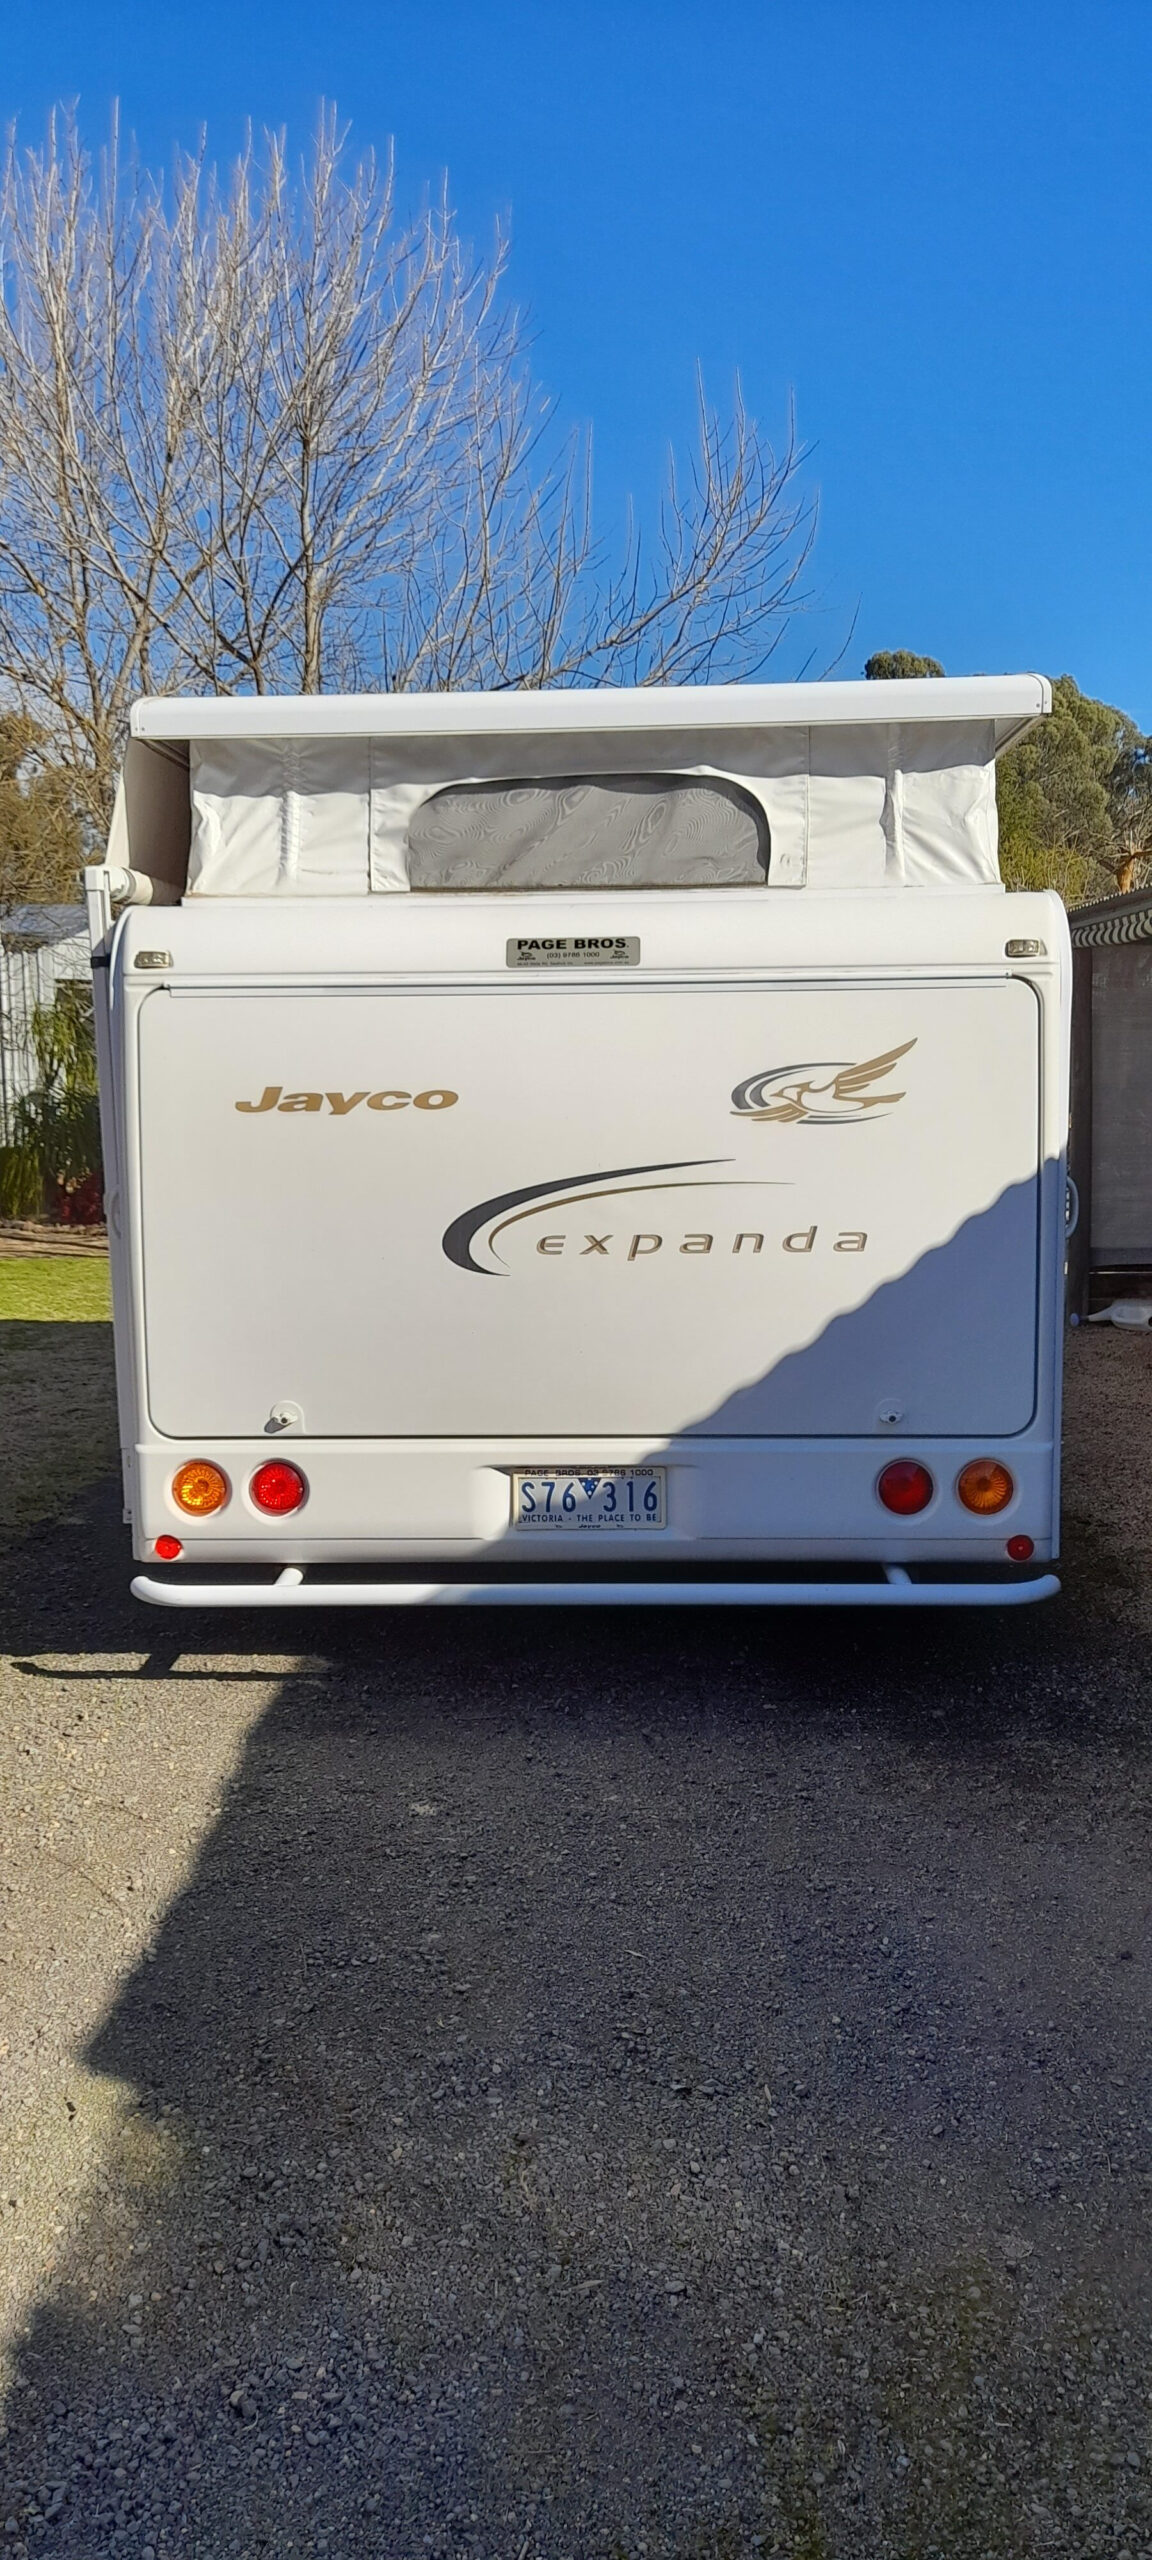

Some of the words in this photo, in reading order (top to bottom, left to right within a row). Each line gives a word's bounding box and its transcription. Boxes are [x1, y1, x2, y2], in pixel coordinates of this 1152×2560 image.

[517, 939, 567, 950] PAGE
[234, 1086, 459, 1116] Jayco
[536, 1225, 870, 1262] expanda
[524, 1469, 549, 1477] PAGE
[555, 1469, 581, 1477] BROS
[587, 1469, 599, 1477] 03
[630, 1468, 654, 1476] 1000
[521, 1481, 577, 1513] S76
[603, 1480, 658, 1513] 316
[522, 1514, 563, 1523] VICTORIA
[576, 1514, 593, 1522] THE
[598, 1514, 625, 1522] PLACE
[630, 1513, 641, 1522] TO
[646, 1513, 657, 1522] BE
